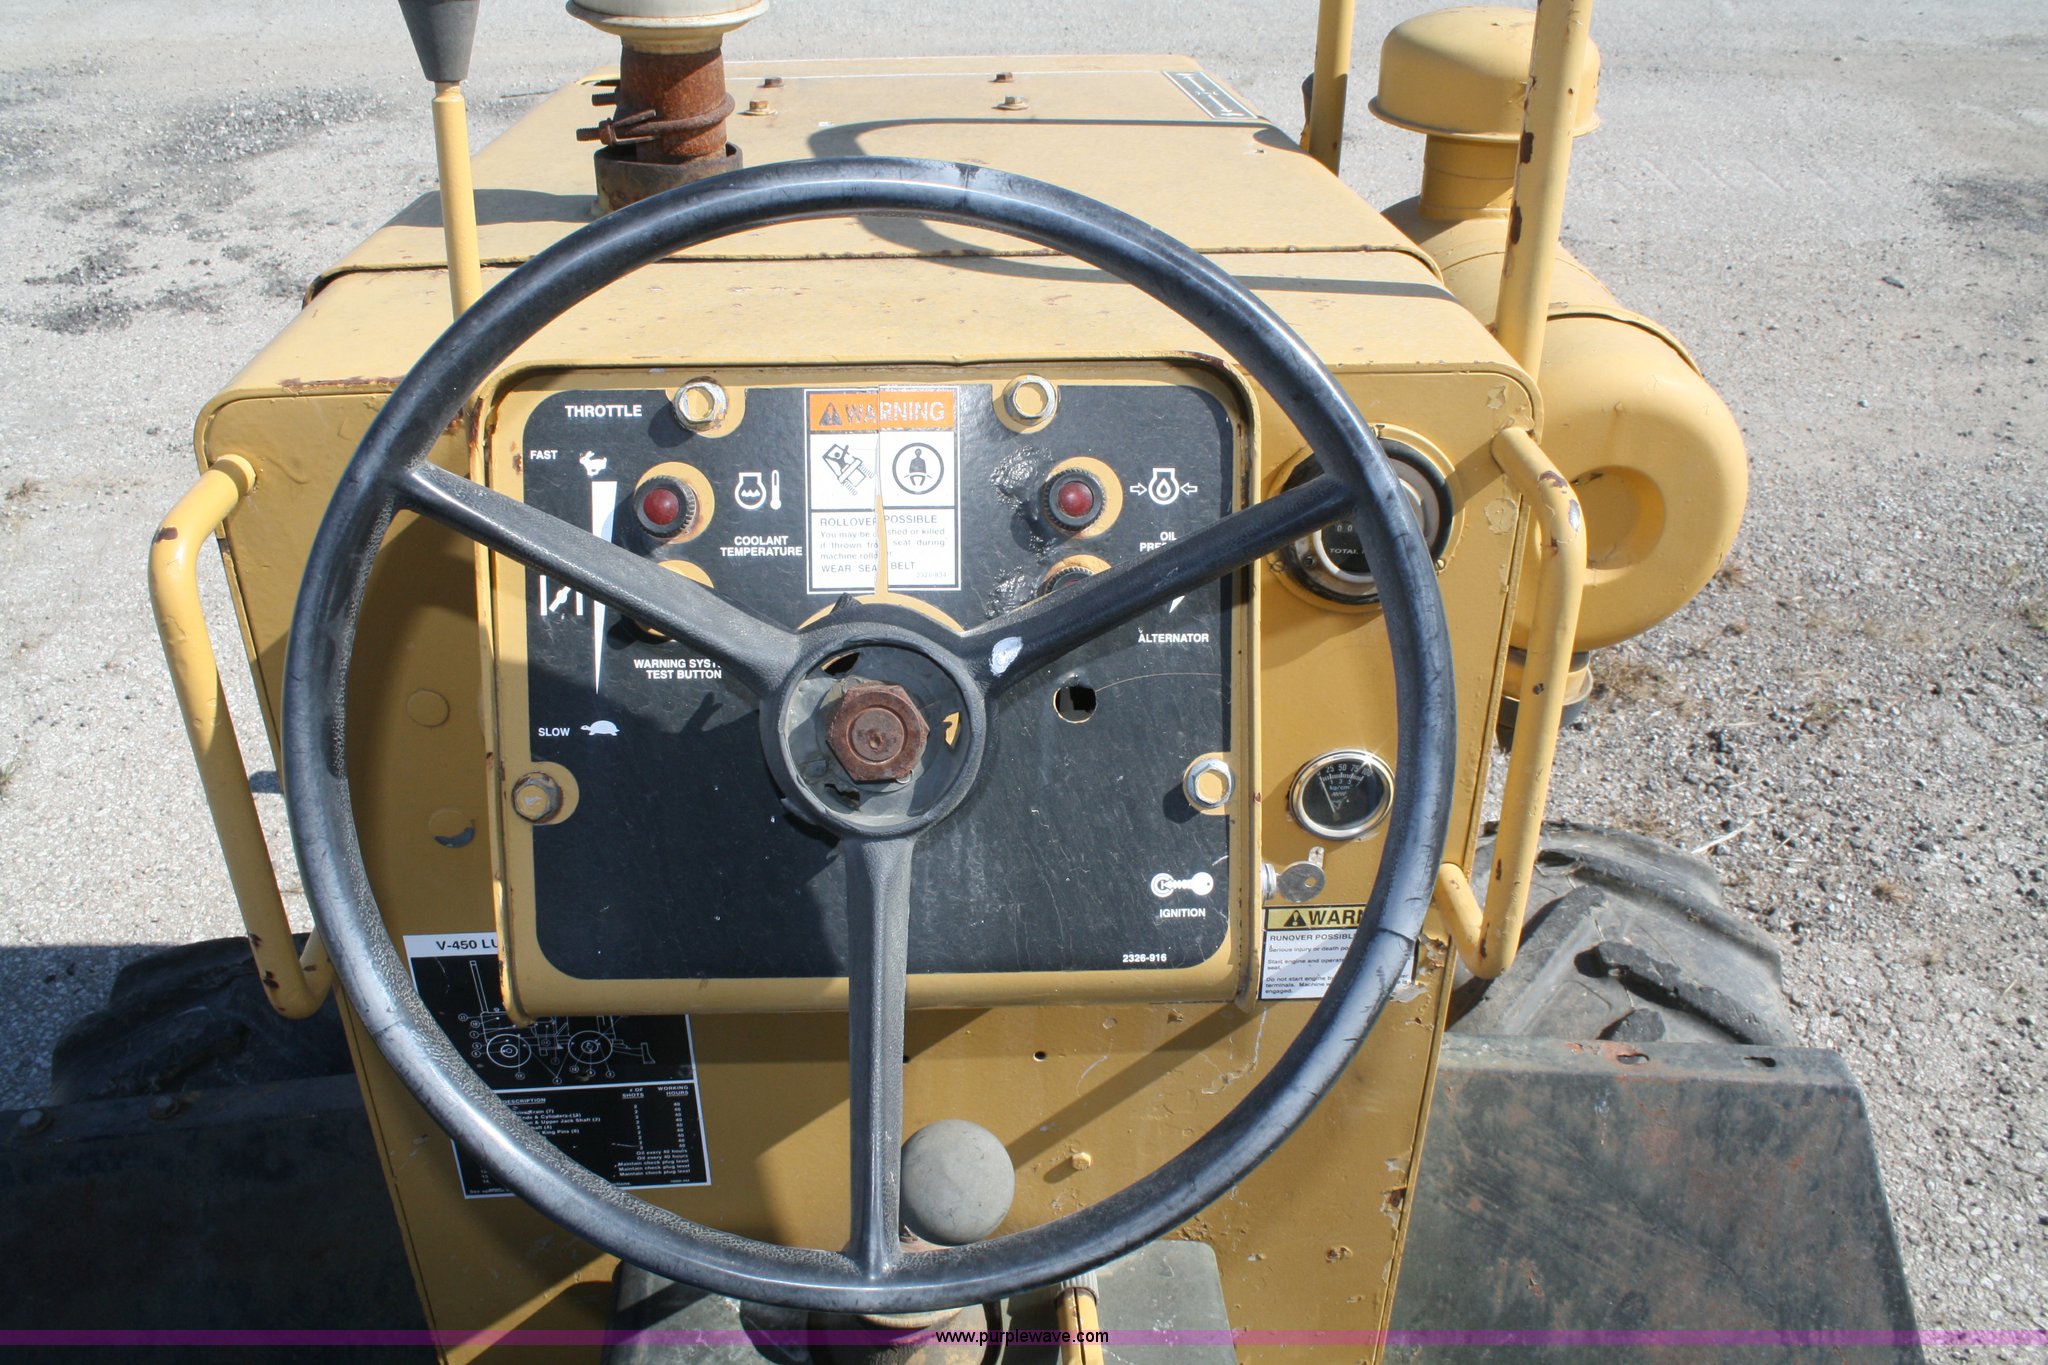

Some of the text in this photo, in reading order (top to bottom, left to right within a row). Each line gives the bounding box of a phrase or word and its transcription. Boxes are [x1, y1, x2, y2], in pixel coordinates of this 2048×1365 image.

[565, 404, 642, 418] THROTTLE
[844, 401, 945, 423] WARNING
[530, 450, 558, 460] FAST
[884, 515, 937, 524] POSSIBLE
[820, 531, 837, 539] You
[839, 532, 856, 540] may
[921, 528, 945, 536] killed
[1160, 531, 1177, 541] OIL
[734, 535, 789, 546] COOLANT
[917, 539, 945, 548] during
[720, 547, 803, 557] TEMPERATURE
[1139, 542, 1167, 552] PRE
[820, 552, 857, 560] machine
[821, 561, 916, 573] WEAR SEA BELT
[1138, 633, 1209, 643] ALTERNATOR
[634, 659, 721, 669] WARNING SYS
[646, 669, 722, 679] TEST BUTTON
[538, 728, 570, 737] SLOW
[1160, 908, 1206, 918] IGNITION
[436, 939, 478, 951] V-450
